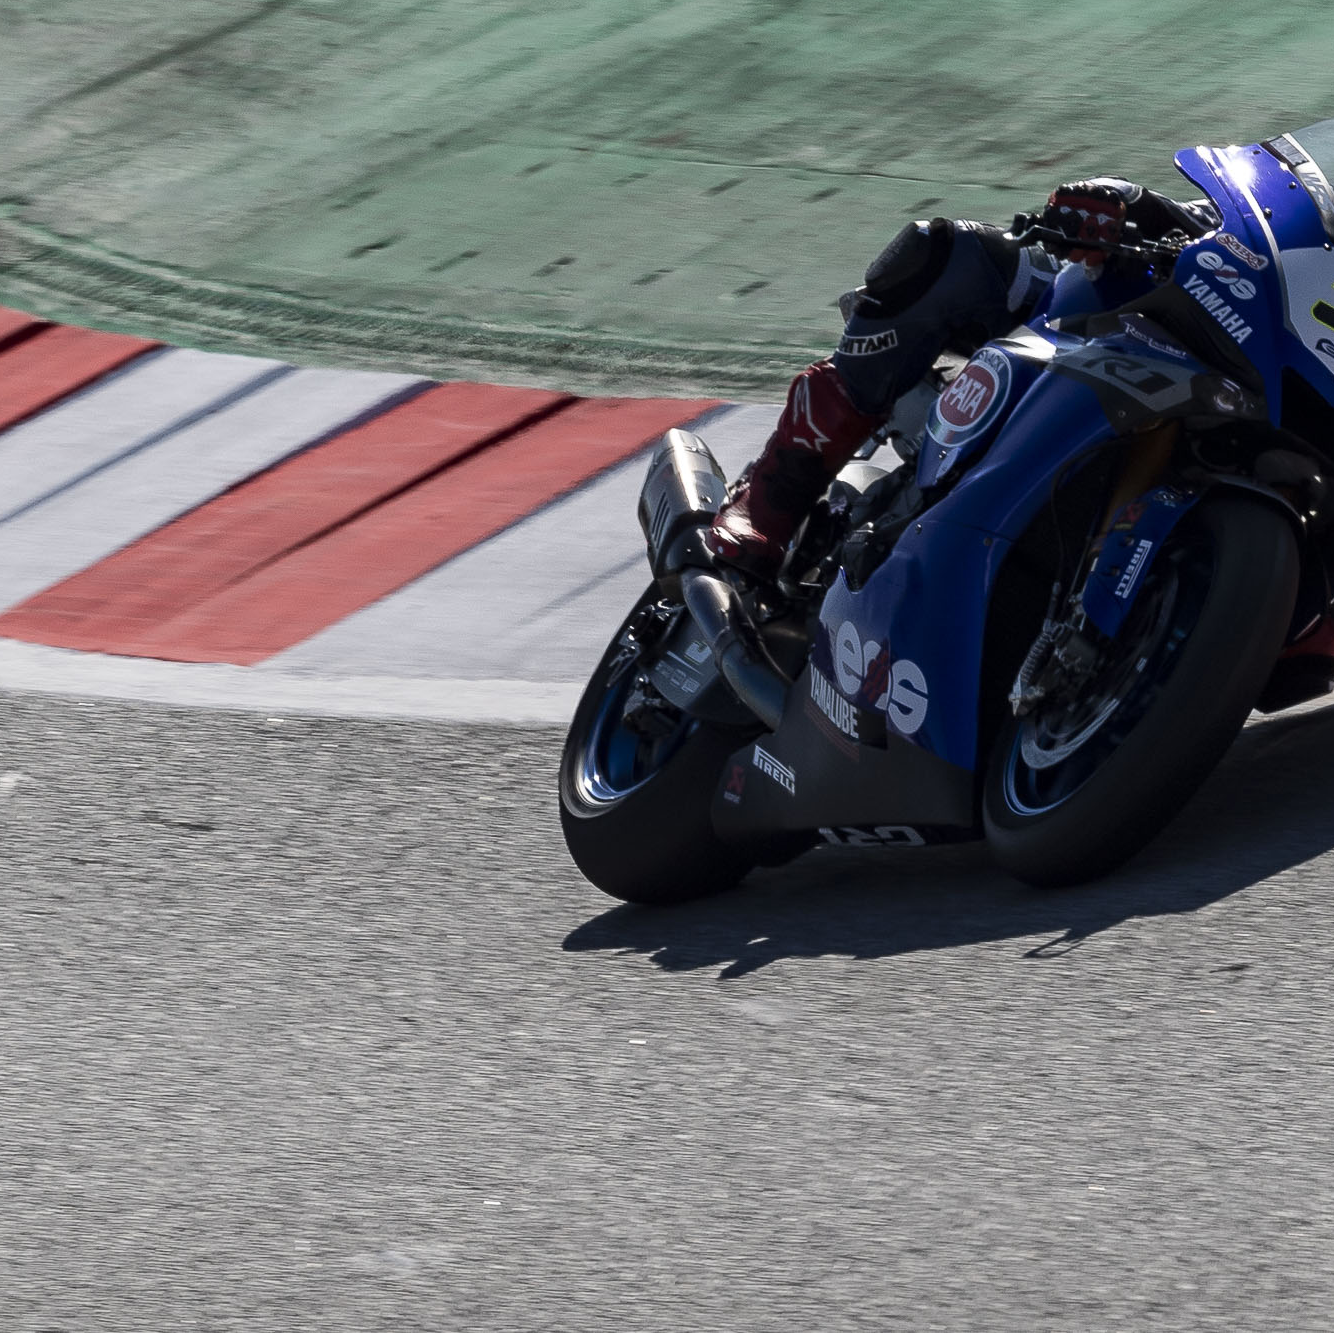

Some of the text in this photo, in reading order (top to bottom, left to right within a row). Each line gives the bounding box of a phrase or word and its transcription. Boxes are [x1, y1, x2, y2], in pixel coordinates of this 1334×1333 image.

[1182, 274, 1253, 344] YAMAHA
[944, 371, 987, 418] PATA
[1114, 539, 1153, 599] PIRELLI
[810, 662, 859, 739] YAMALUBE
[753, 744, 795, 796] PIRELLI
